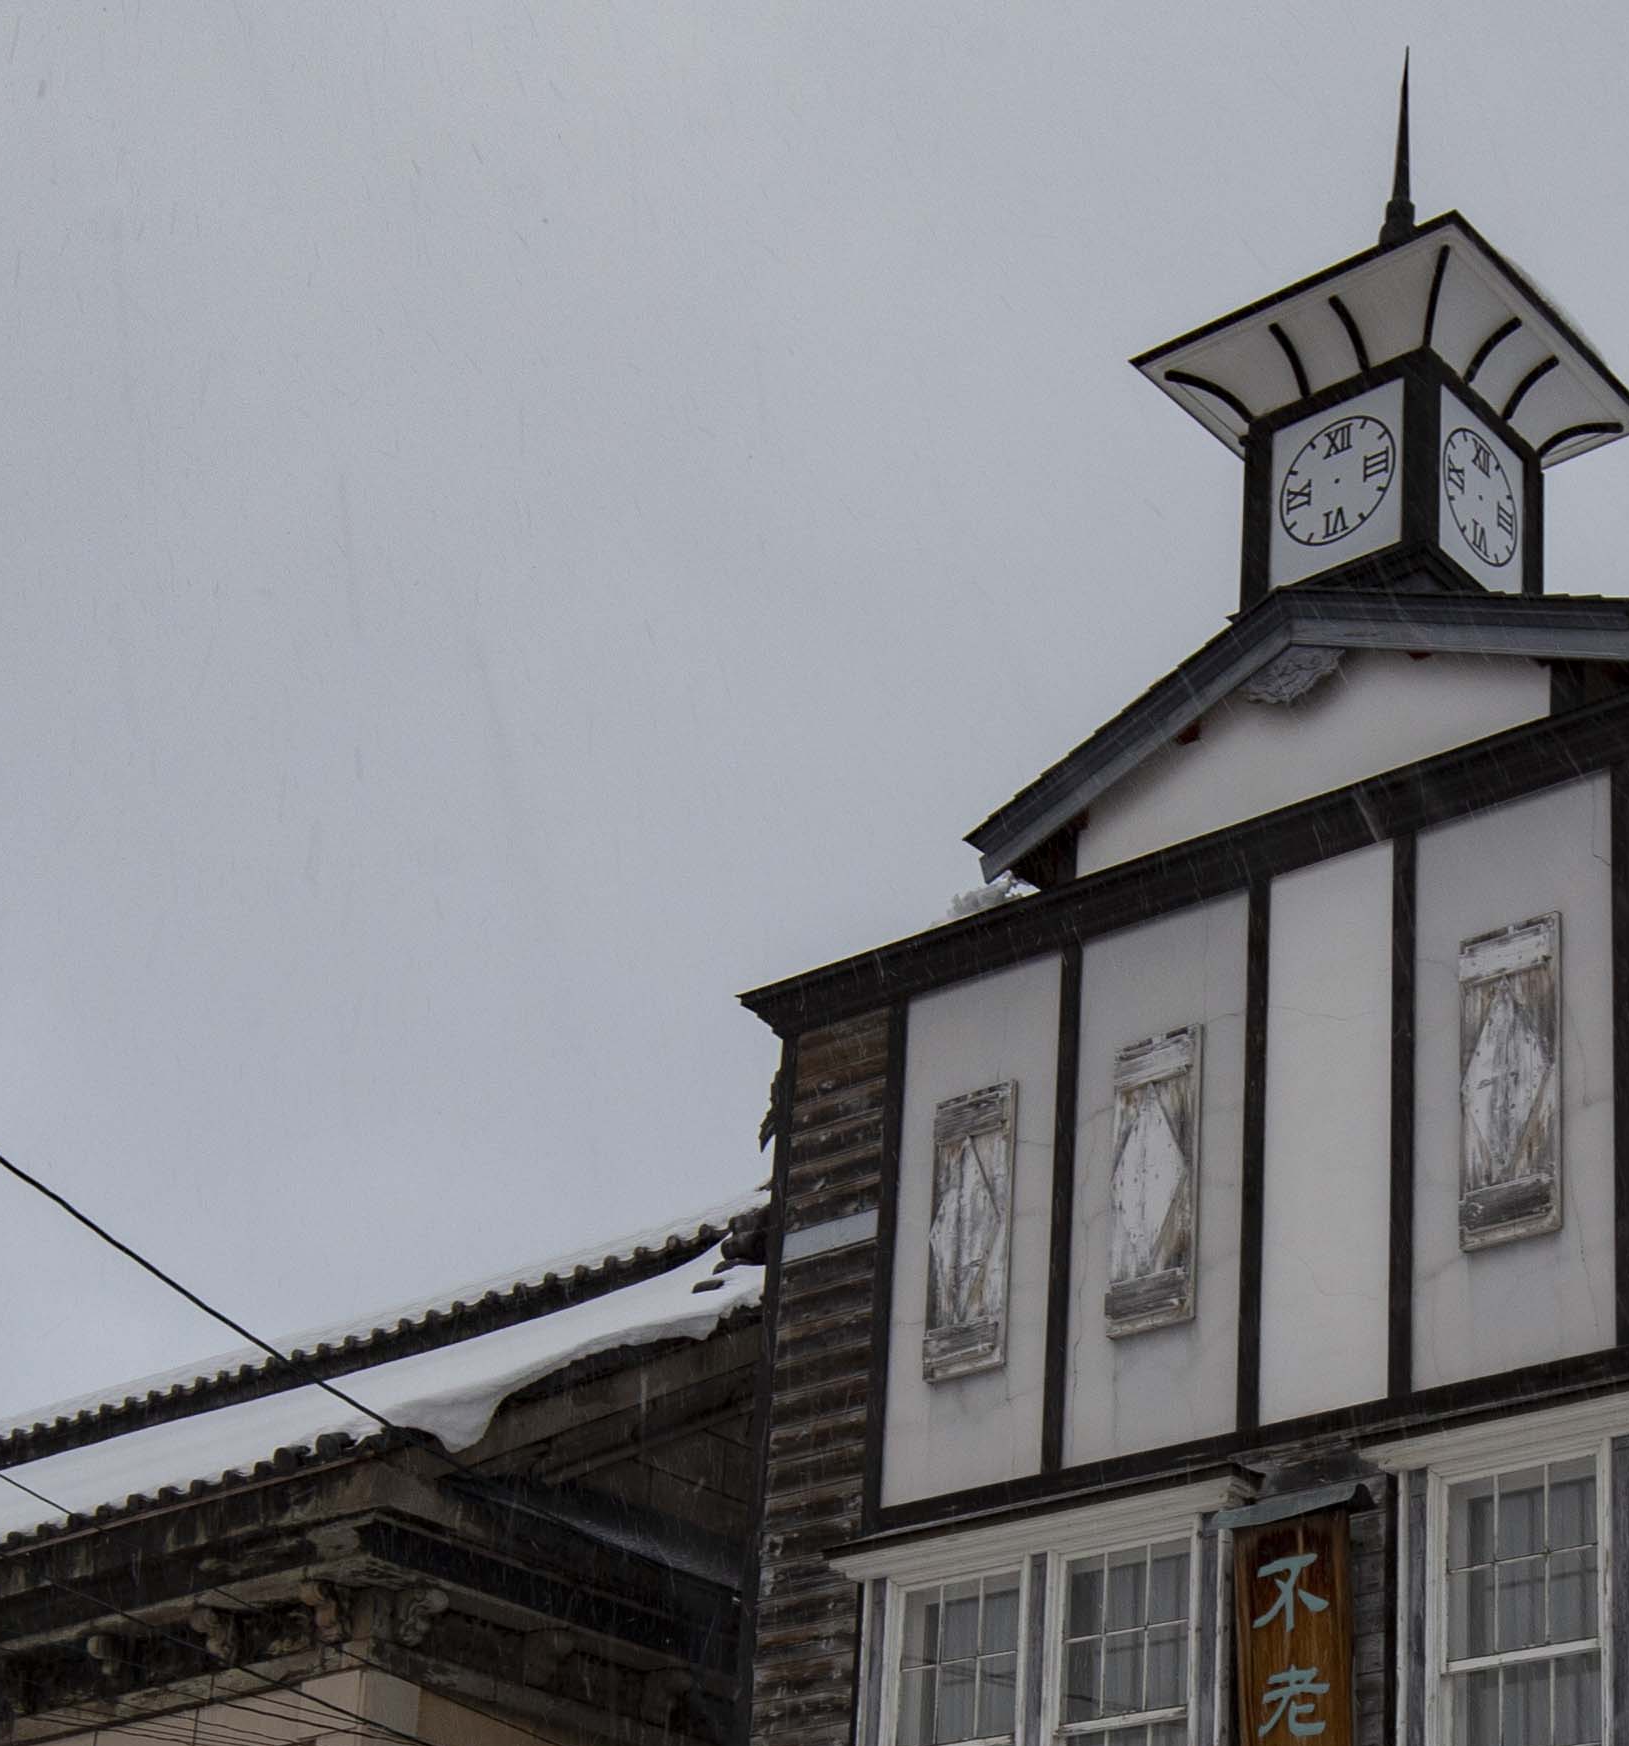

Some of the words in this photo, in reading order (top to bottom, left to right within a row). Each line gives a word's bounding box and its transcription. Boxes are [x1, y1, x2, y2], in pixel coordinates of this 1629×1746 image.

[1323, 423, 1353, 460] XII
[1472, 439, 1490, 478] XII
[1363, 446, 1389, 482] III
[1447, 456, 1465, 494] IX
[1287, 479, 1312, 515] IX
[1322, 507, 1349, 539] VI
[1472, 519, 1490, 558] VI
[1497, 502, 1514, 540] III
